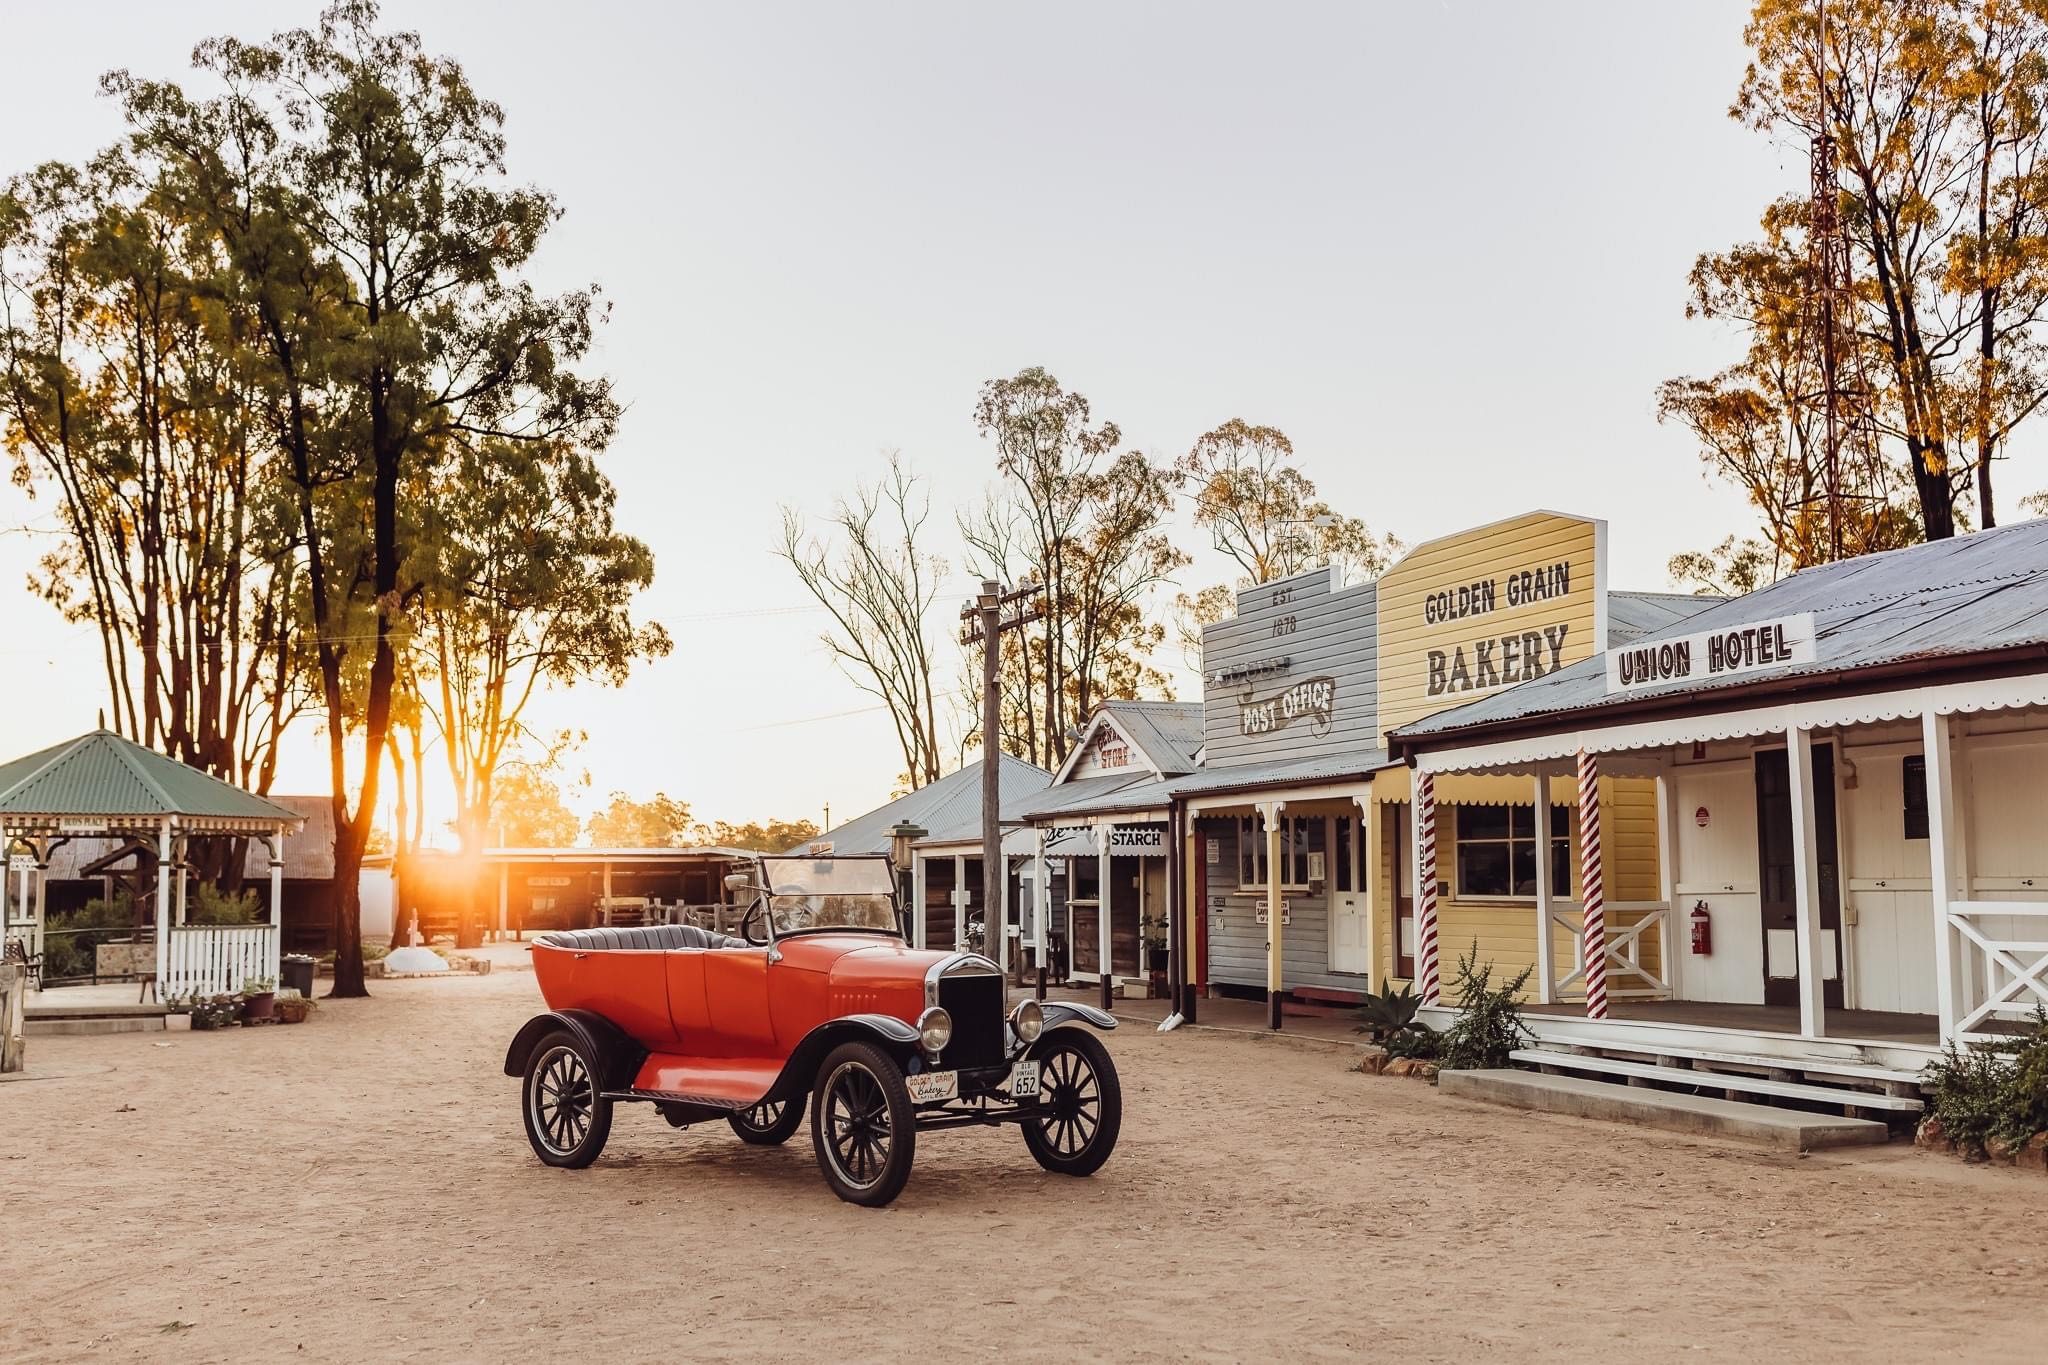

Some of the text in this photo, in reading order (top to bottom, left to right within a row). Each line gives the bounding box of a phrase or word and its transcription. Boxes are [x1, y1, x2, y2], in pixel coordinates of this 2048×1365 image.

[1424, 561, 1570, 625] GOLDEN GRAIN
[1272, 615, 1297, 637] 1878
[1427, 624, 1569, 697] BAKERY
[1618, 623, 1792, 686] UNION HOTEL
[1243, 682, 1331, 734] POST OFFICE
[1101, 747, 1128, 768] STORE
[1111, 833, 1161, 846] STARCH
[1417, 788, 1426, 897] BARBER
[1016, 1076, 1036, 1094] 652
